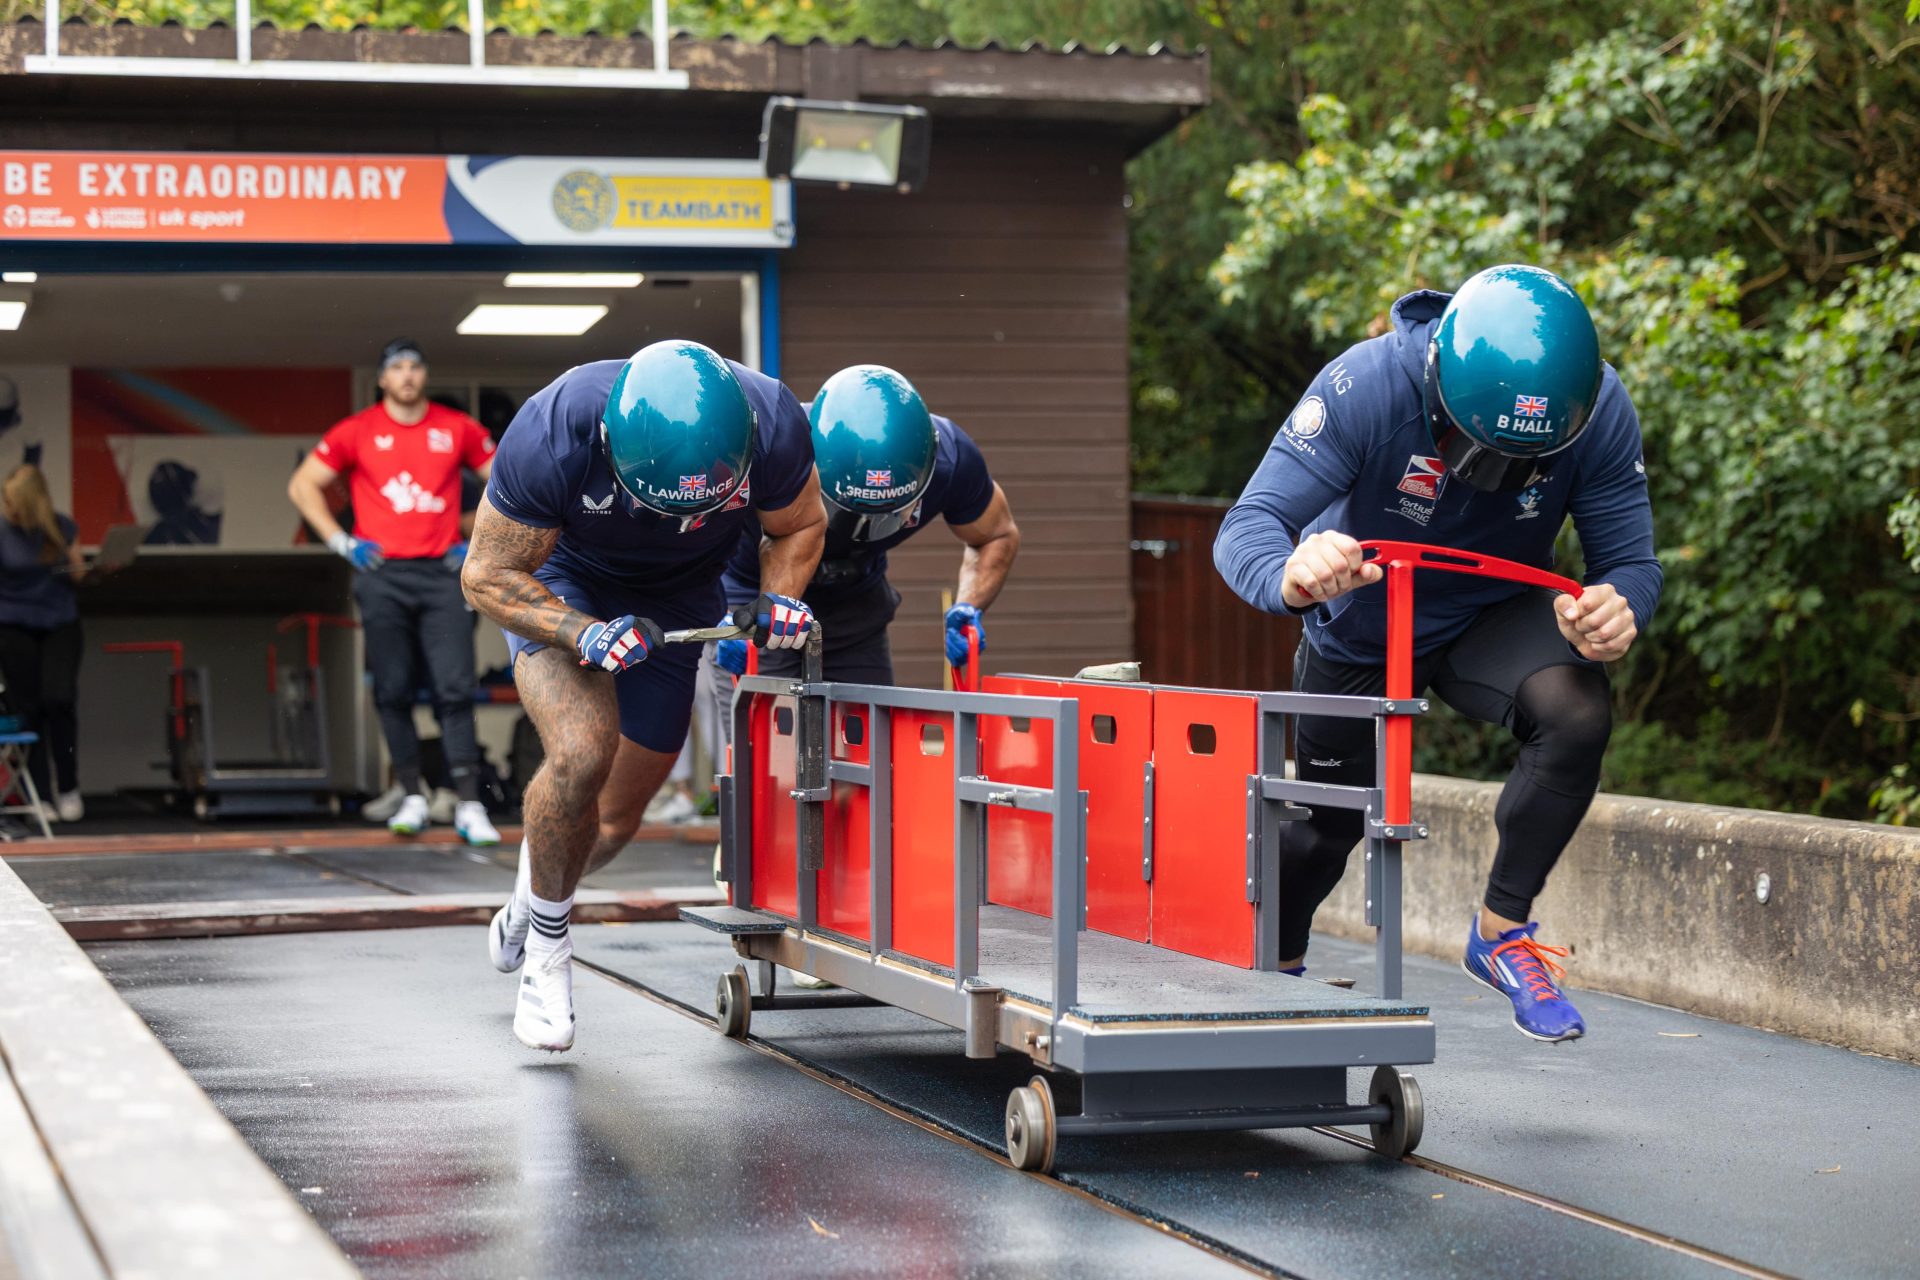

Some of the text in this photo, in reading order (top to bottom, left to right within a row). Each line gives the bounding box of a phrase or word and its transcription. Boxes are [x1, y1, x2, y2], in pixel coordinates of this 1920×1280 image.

[4, 162, 408, 200] BE EXTRAORDINARY
[158, 207, 185, 227] uk
[188, 208, 246, 231] sport
[626, 199, 763, 223] TEAMBATH
[1496, 414, 1554, 434] B HALL
[1298, 438, 1317, 456] HALL
[635, 477, 734, 501] T LAWRENCE
[1400, 506, 1431, 523] clinic
[596, 621, 625, 652] SEIZ
